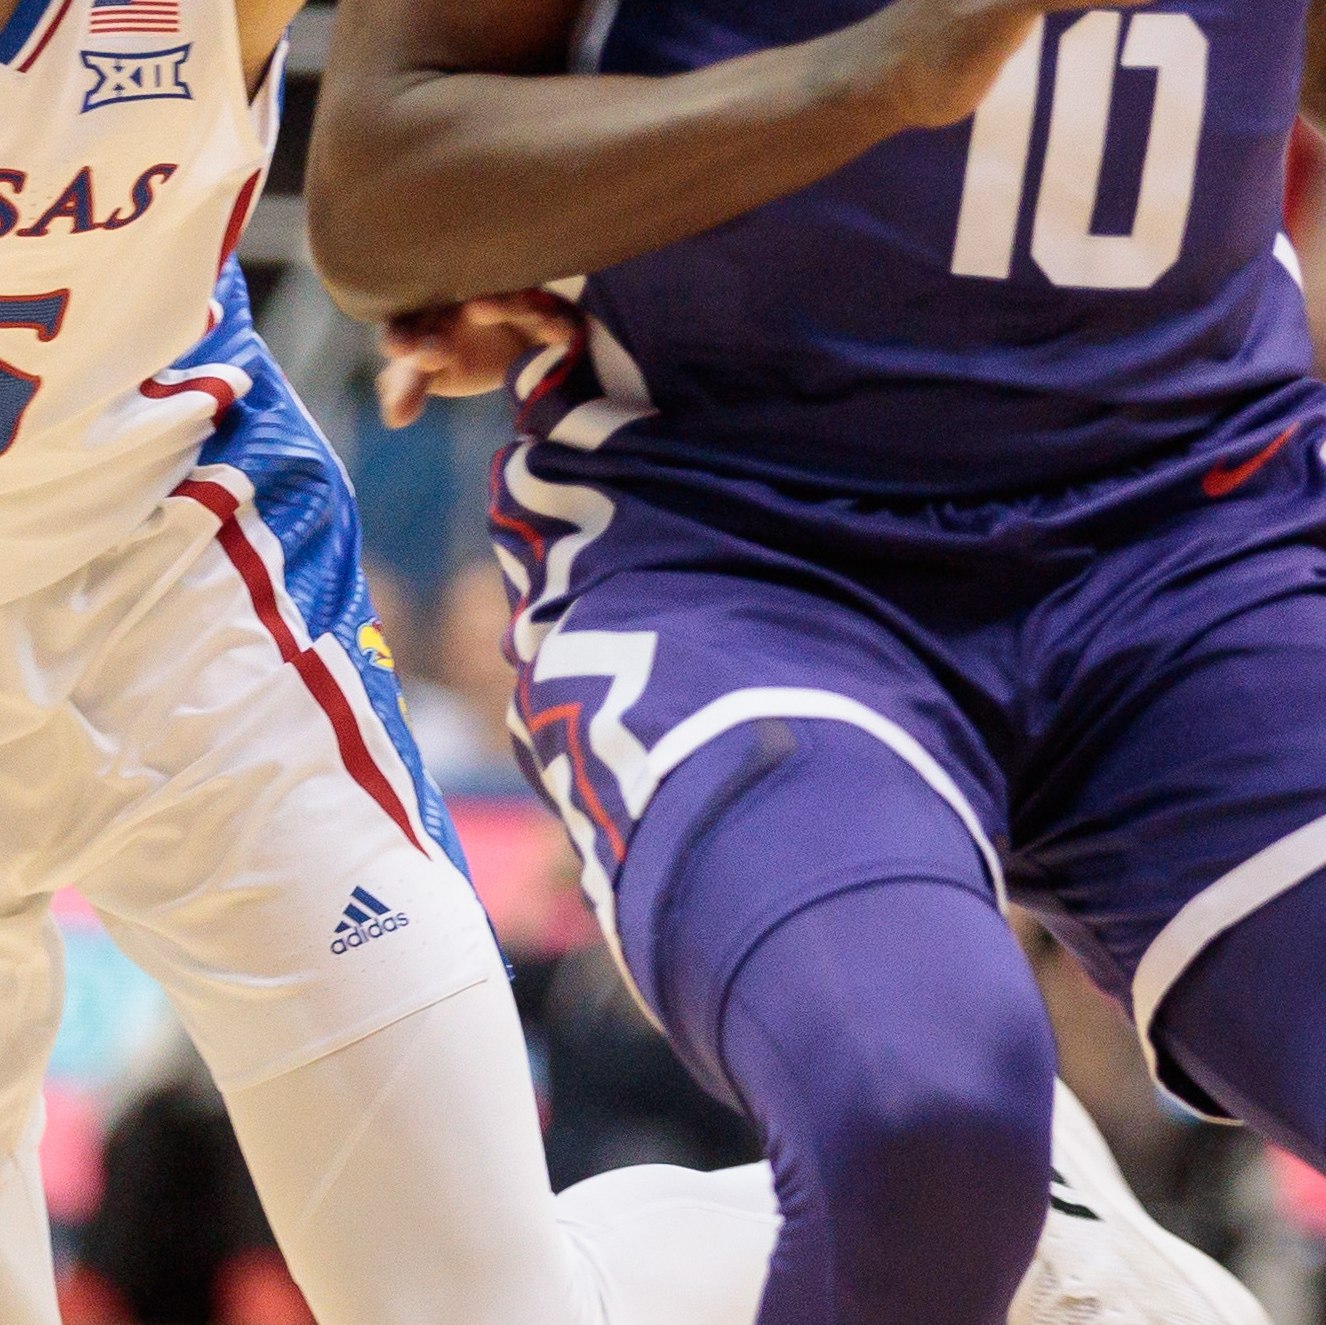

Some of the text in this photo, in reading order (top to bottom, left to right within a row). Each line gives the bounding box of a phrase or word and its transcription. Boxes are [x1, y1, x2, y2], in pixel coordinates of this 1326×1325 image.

[80, 42, 194, 114] XII
[950, 9, 1209, 291] 10
[330, 912, 409, 955] adidas
